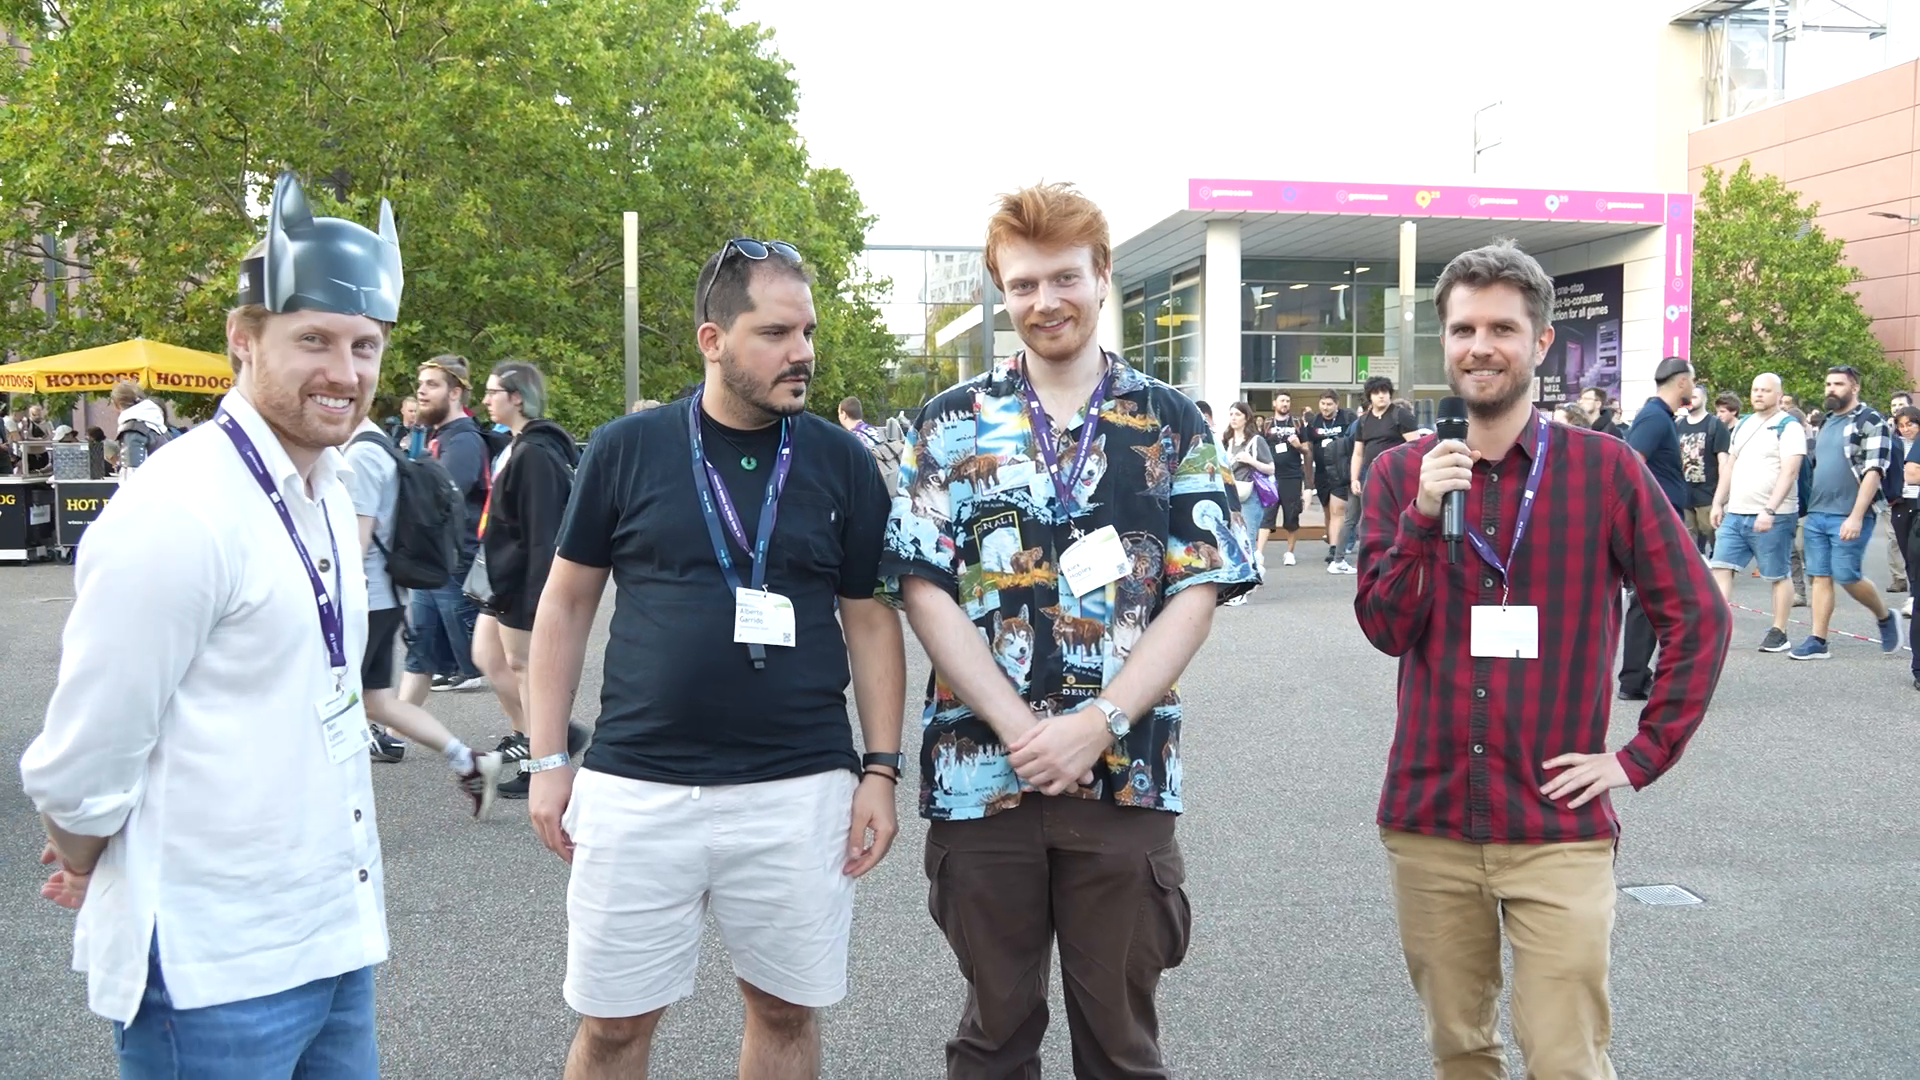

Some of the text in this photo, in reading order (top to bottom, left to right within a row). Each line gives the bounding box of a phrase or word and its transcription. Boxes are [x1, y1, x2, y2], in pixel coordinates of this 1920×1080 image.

[0, 374, 34, 388] OTDOGS
[156, 372, 233, 389] HOTDOG
[66, 498, 99, 511] HOT
[977, 515, 1014, 535] DNALI
[740, 608, 764, 616] Alberto
[740, 616, 764, 625] Garrido
